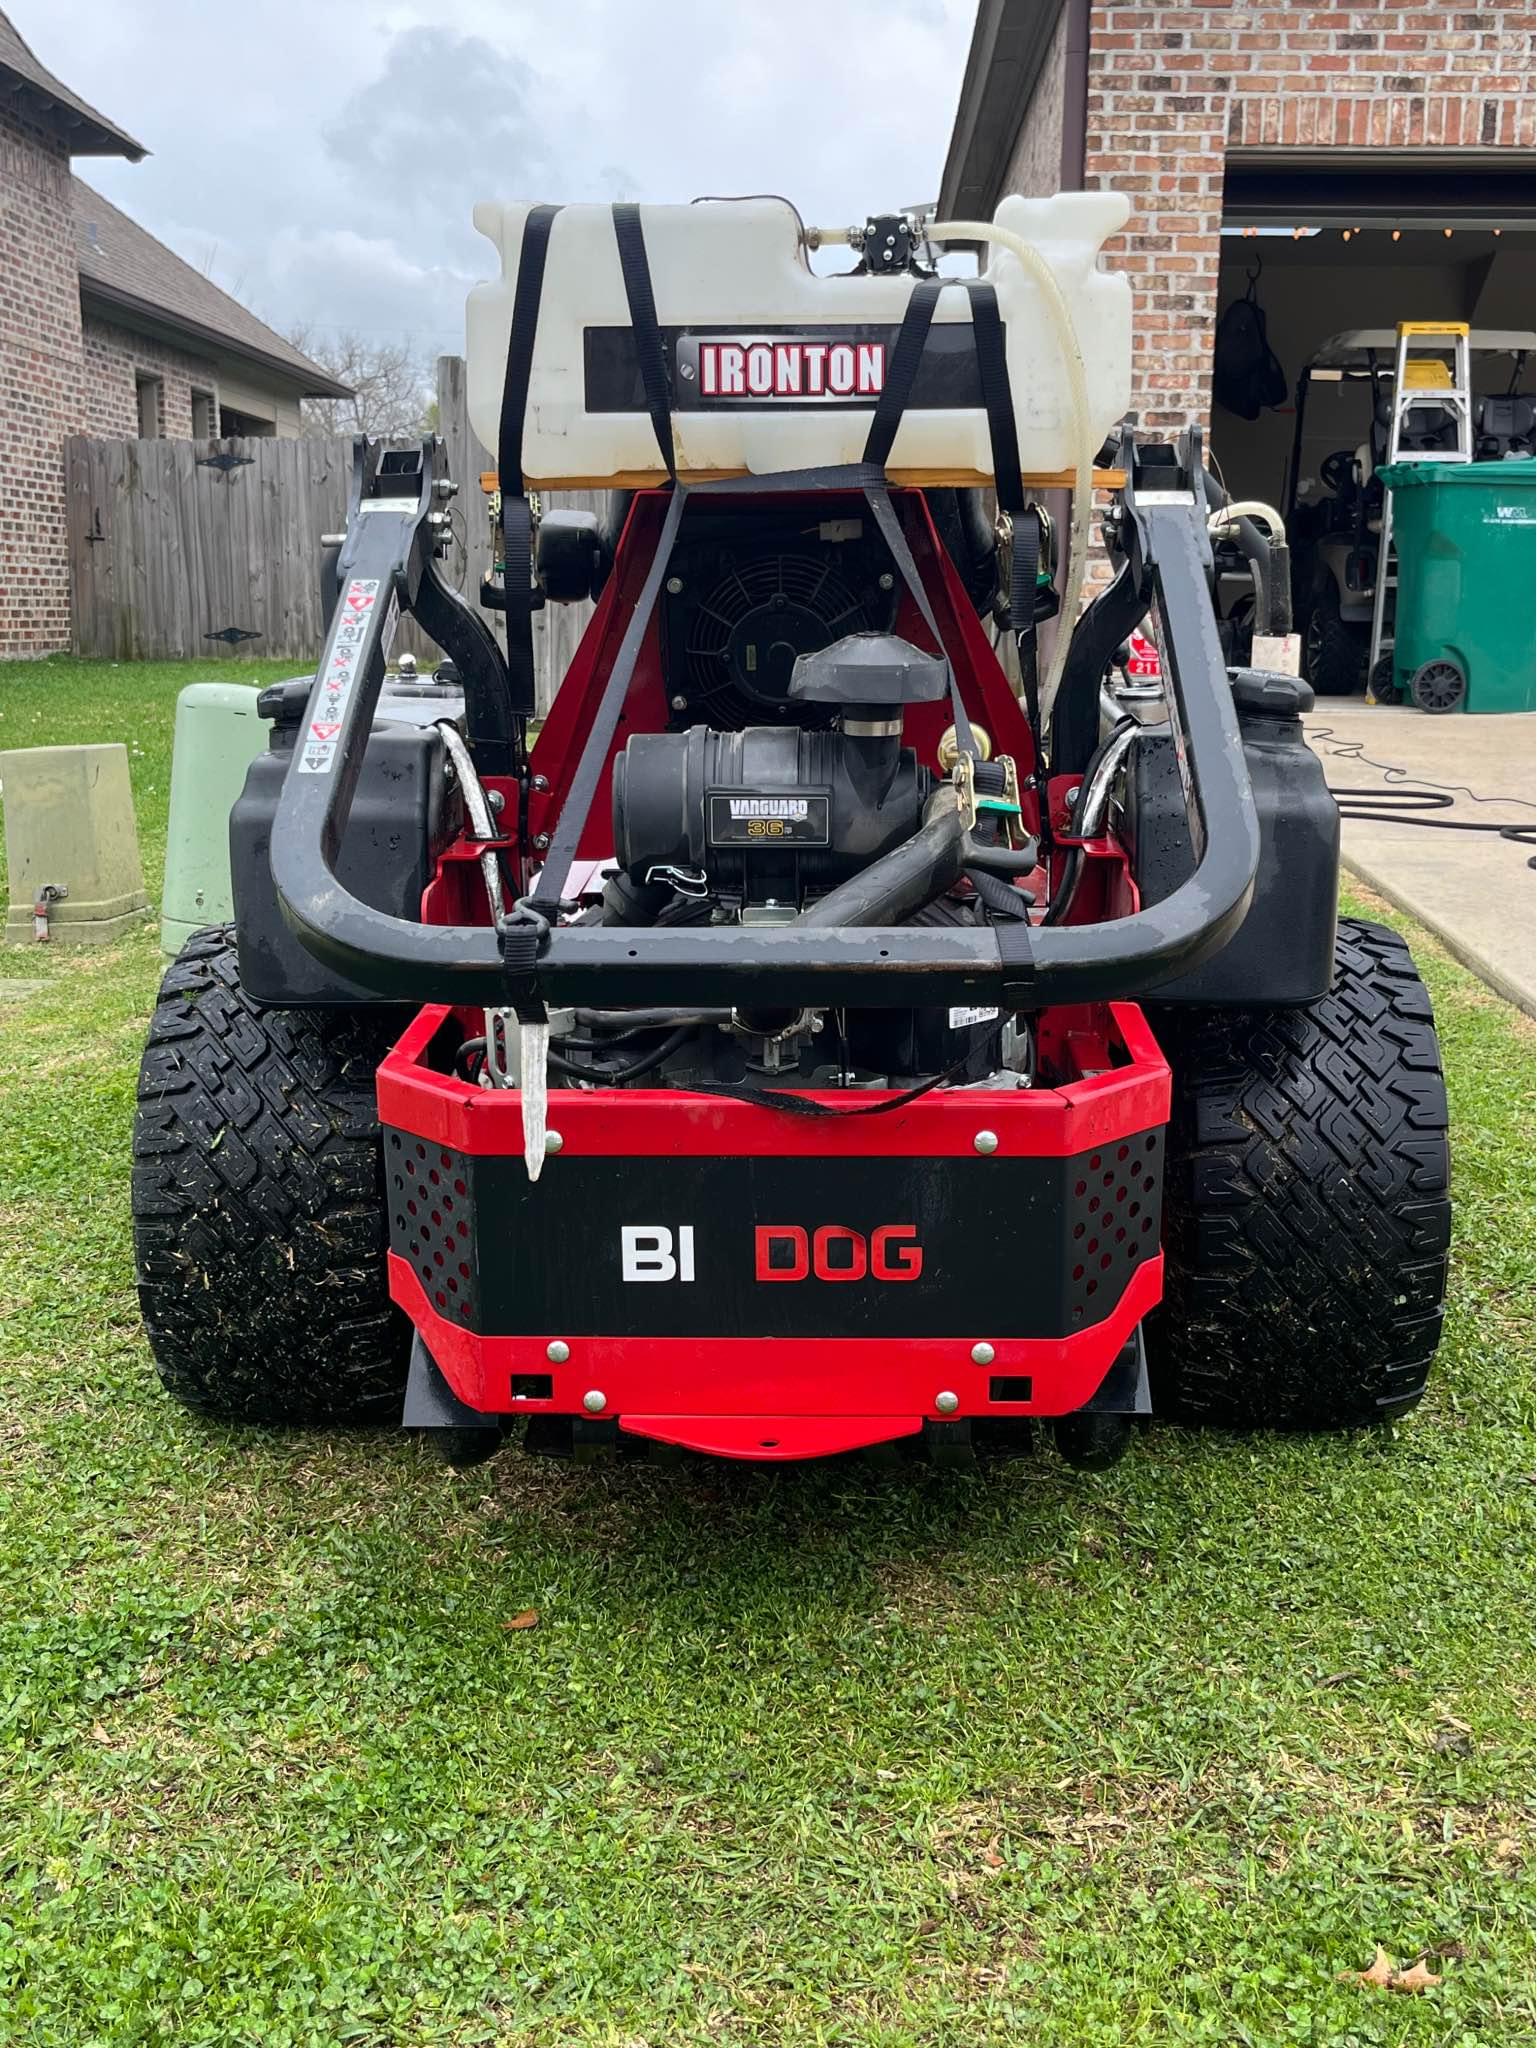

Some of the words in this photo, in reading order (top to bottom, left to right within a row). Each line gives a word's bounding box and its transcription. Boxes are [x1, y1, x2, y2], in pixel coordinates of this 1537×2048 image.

[702, 344, 885, 395] IRONTON
[730, 800, 808, 815] VANGUARD
[747, 819, 784, 836] 36
[621, 1225, 695, 1282] BI
[754, 1225, 923, 1281] DOG
